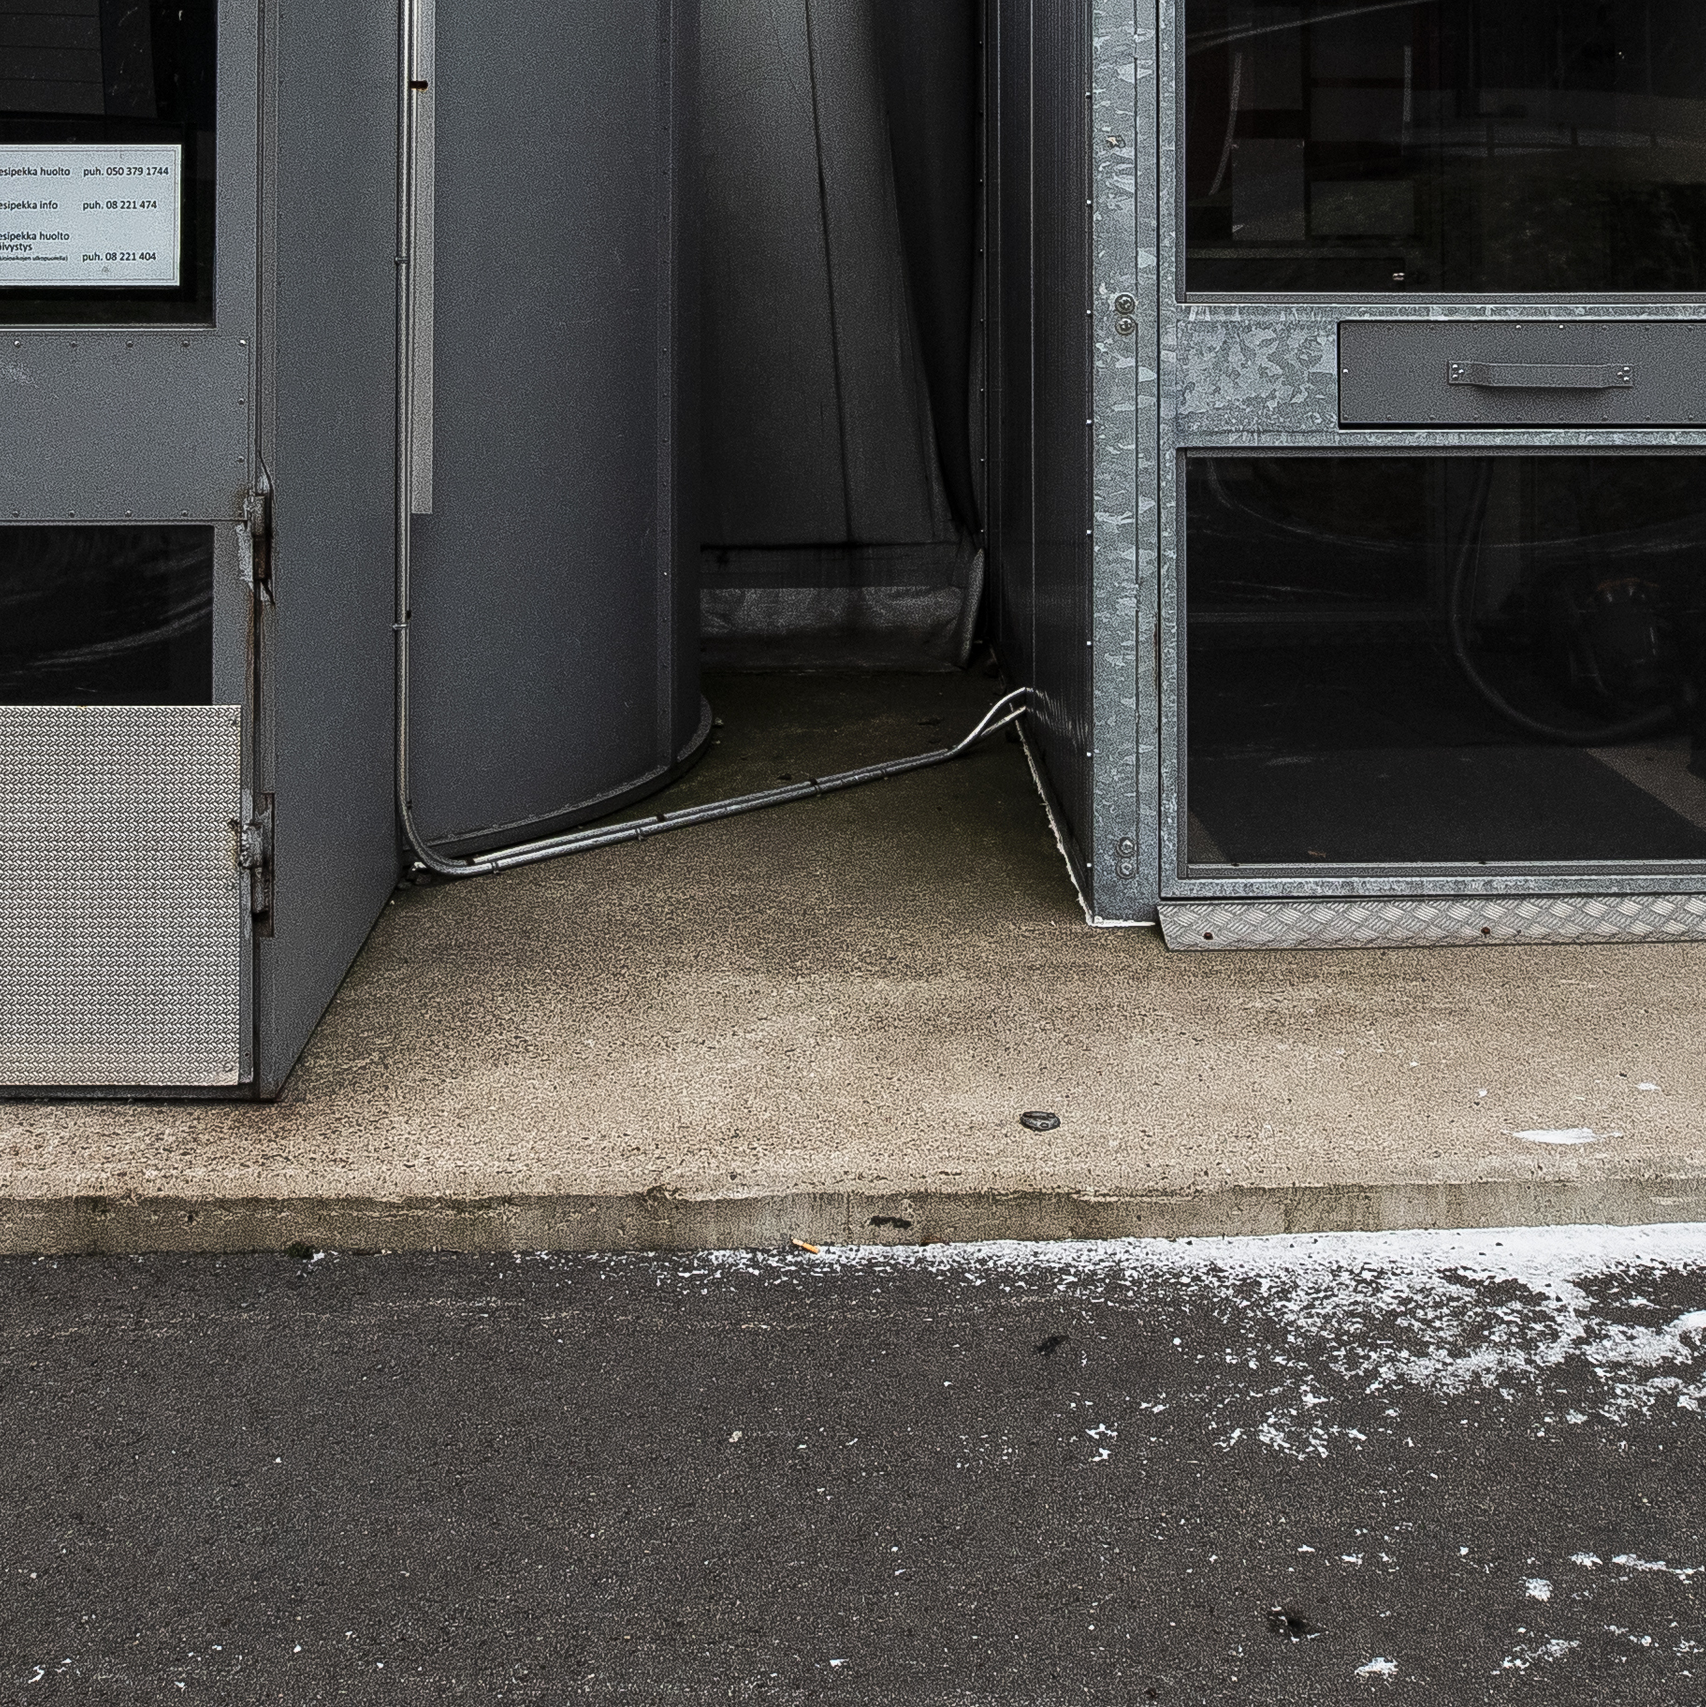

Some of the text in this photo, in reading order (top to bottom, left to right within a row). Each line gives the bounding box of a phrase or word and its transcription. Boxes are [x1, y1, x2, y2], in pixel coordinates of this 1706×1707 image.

[40, 166, 71, 176] huolto
[83, 166, 169, 177] puh. 050 379 1744
[39, 200, 59, 210] info
[82, 200, 158, 211] puh. 08 221 474
[39, 231, 70, 241] huolto
[82, 252, 157, 263] puh. 08 221 404
